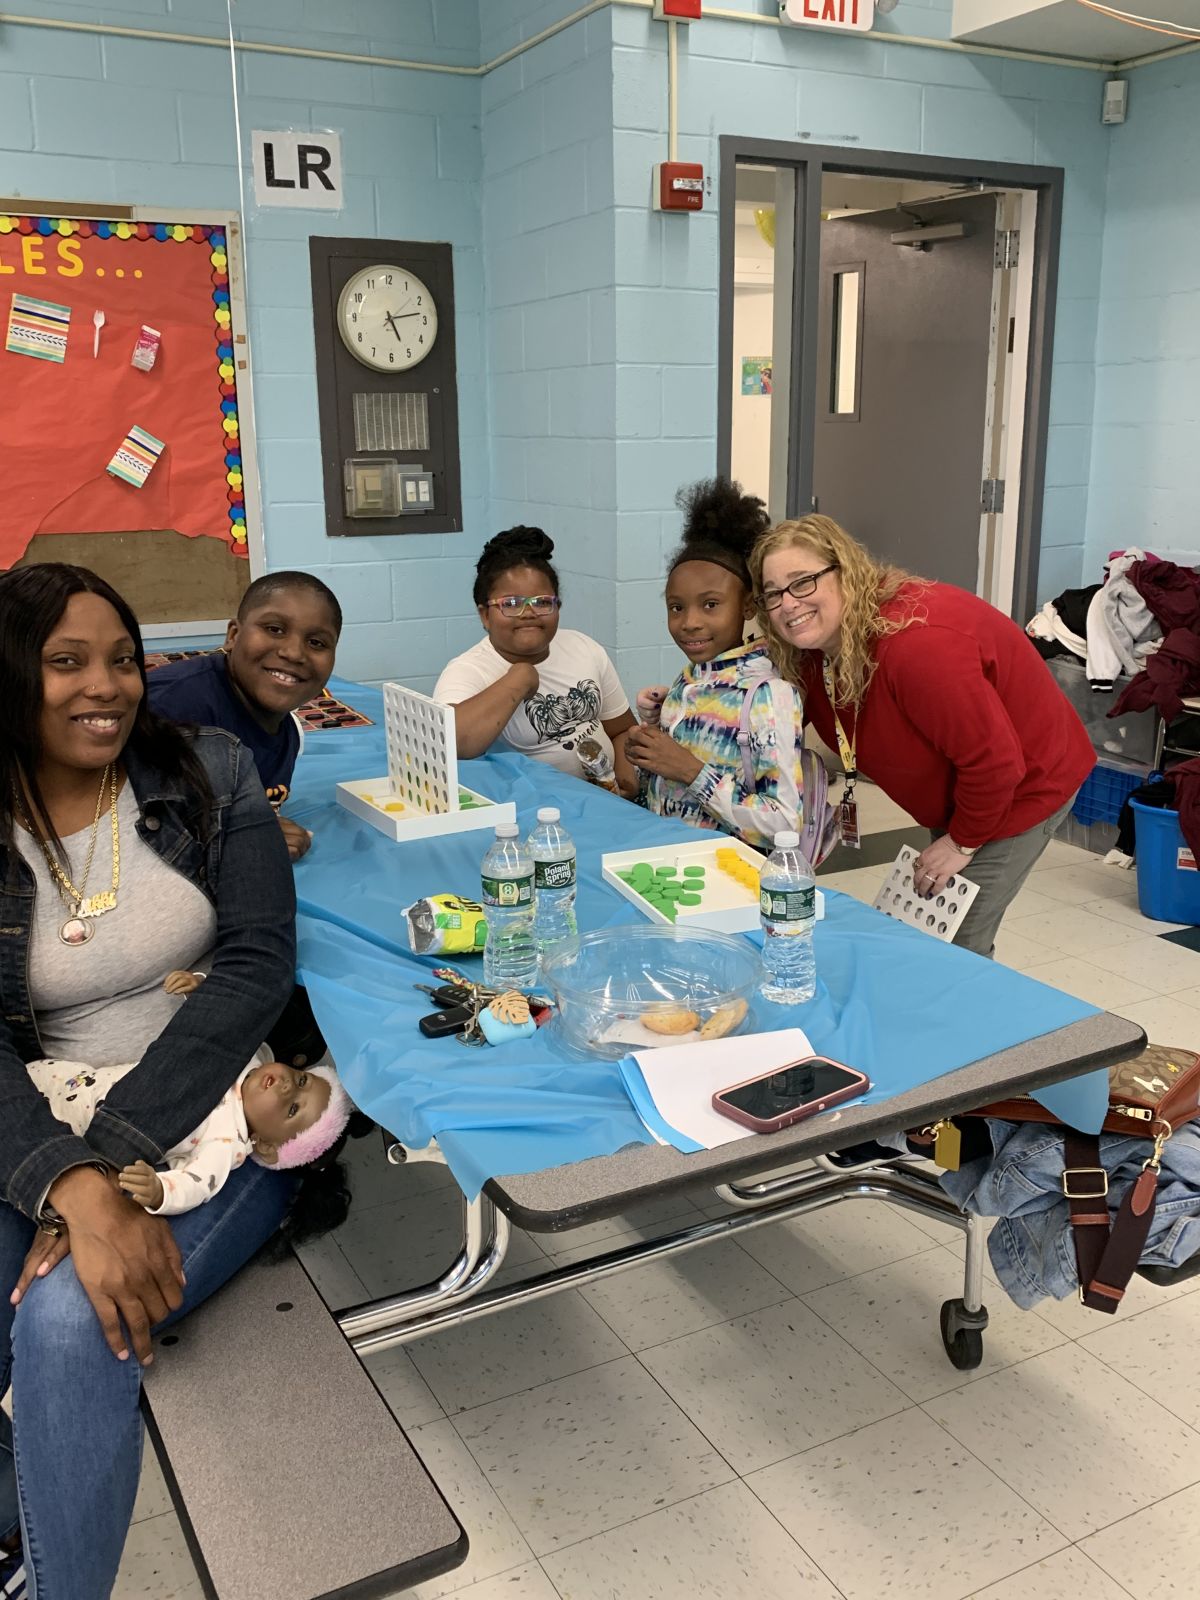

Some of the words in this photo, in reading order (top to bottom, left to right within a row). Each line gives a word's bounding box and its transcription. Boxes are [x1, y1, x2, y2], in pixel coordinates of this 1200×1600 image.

[263, 142, 336, 191] LR
[367, 279, 375, 289] 11
[385, 275, 393, 285] 12
[354, 293, 363, 303] 10
[417, 296, 422, 306] 2
[352, 312, 357, 323] 9
[422, 315, 428, 326] 3
[357, 332, 363, 342] 8
[418, 334, 424, 344] 4
[371, 347, 376, 357] 7
[406, 348, 411, 358] 5
[389, 352, 394, 363] 6
[544, 862, 570, 877] Poland
[545, 870, 571, 886] Spring
